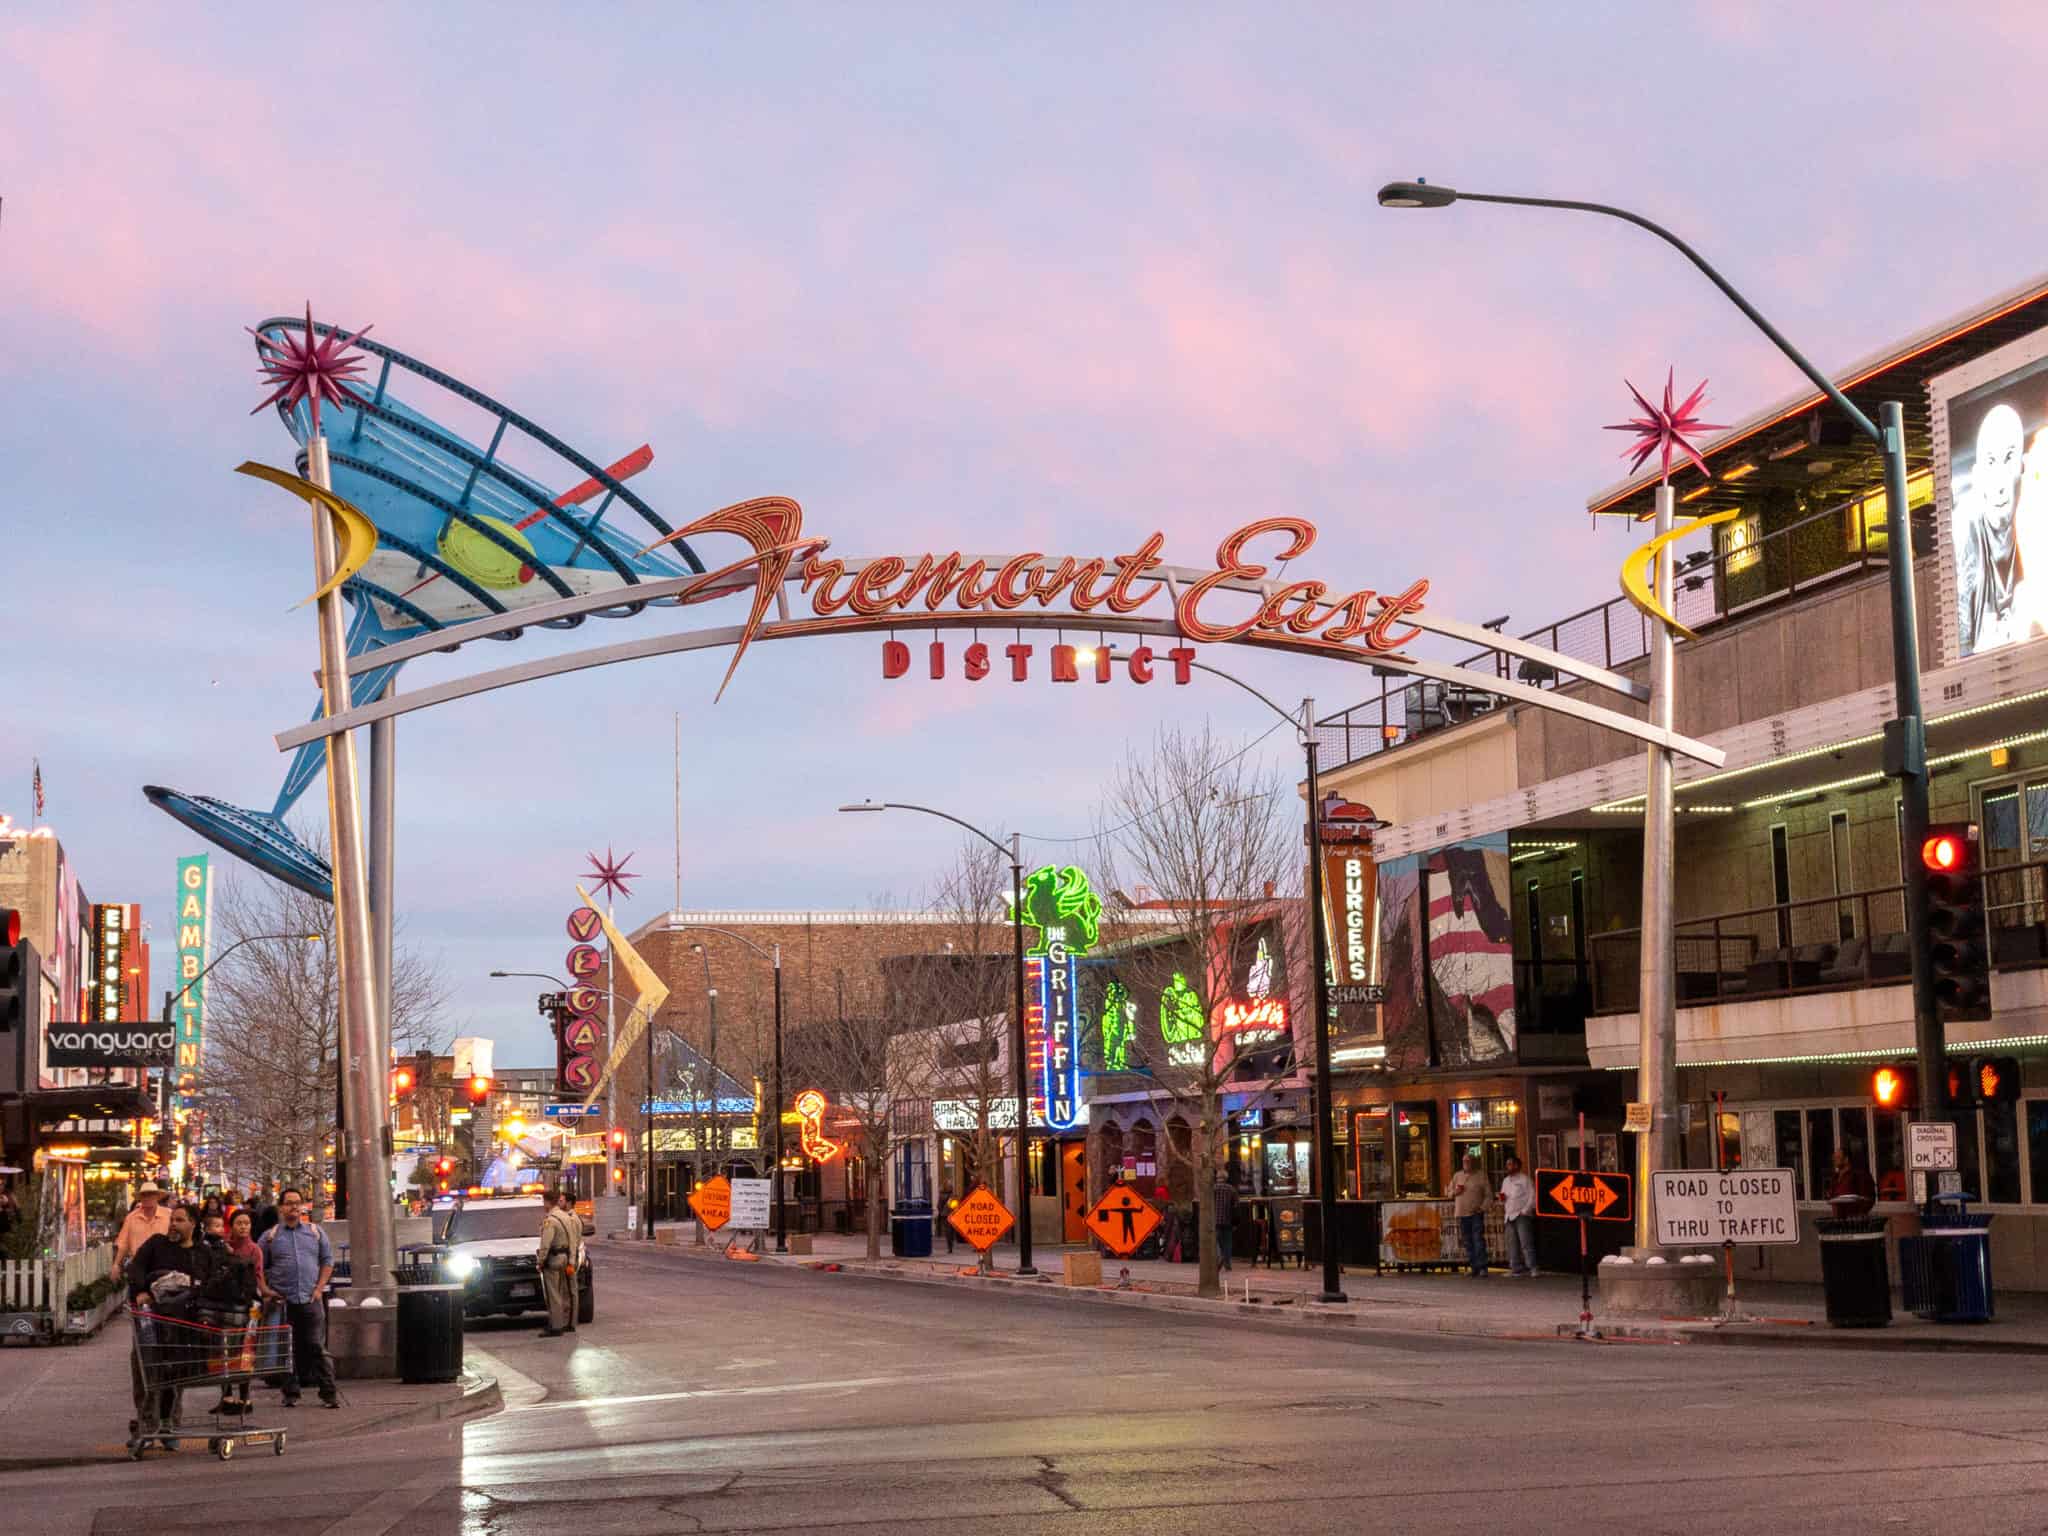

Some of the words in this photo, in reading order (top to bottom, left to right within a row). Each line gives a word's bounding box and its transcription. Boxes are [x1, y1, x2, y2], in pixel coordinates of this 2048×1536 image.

[635, 496, 1165, 703] Fremont
[1175, 516, 1429, 653] East
[882, 640, 1197, 686] DISTRICT
[1345, 859, 1367, 981] BURGERS
[569, 910, 600, 1088] VEGAS
[48, 1026, 175, 1055] vanguard
[1048, 942, 1072, 1122] GRIFFIN
[1915, 1152, 1931, 1163] OK
[1562, 1187, 1606, 1204] DETOUR
[1666, 1179, 1708, 1197] ROAD
[1719, 1178, 1782, 1196] CLOSED
[702, 1208, 729, 1219] AHEAD
[970, 1202, 994, 1211] ROAD
[1717, 1200, 1734, 1215] TO
[965, 1214, 1001, 1225] CLOSED
[1668, 1219, 1710, 1237] THRU
[1718, 1218, 1786, 1236] TRAFFIC
[967, 1227, 999, 1236] AHEAD
